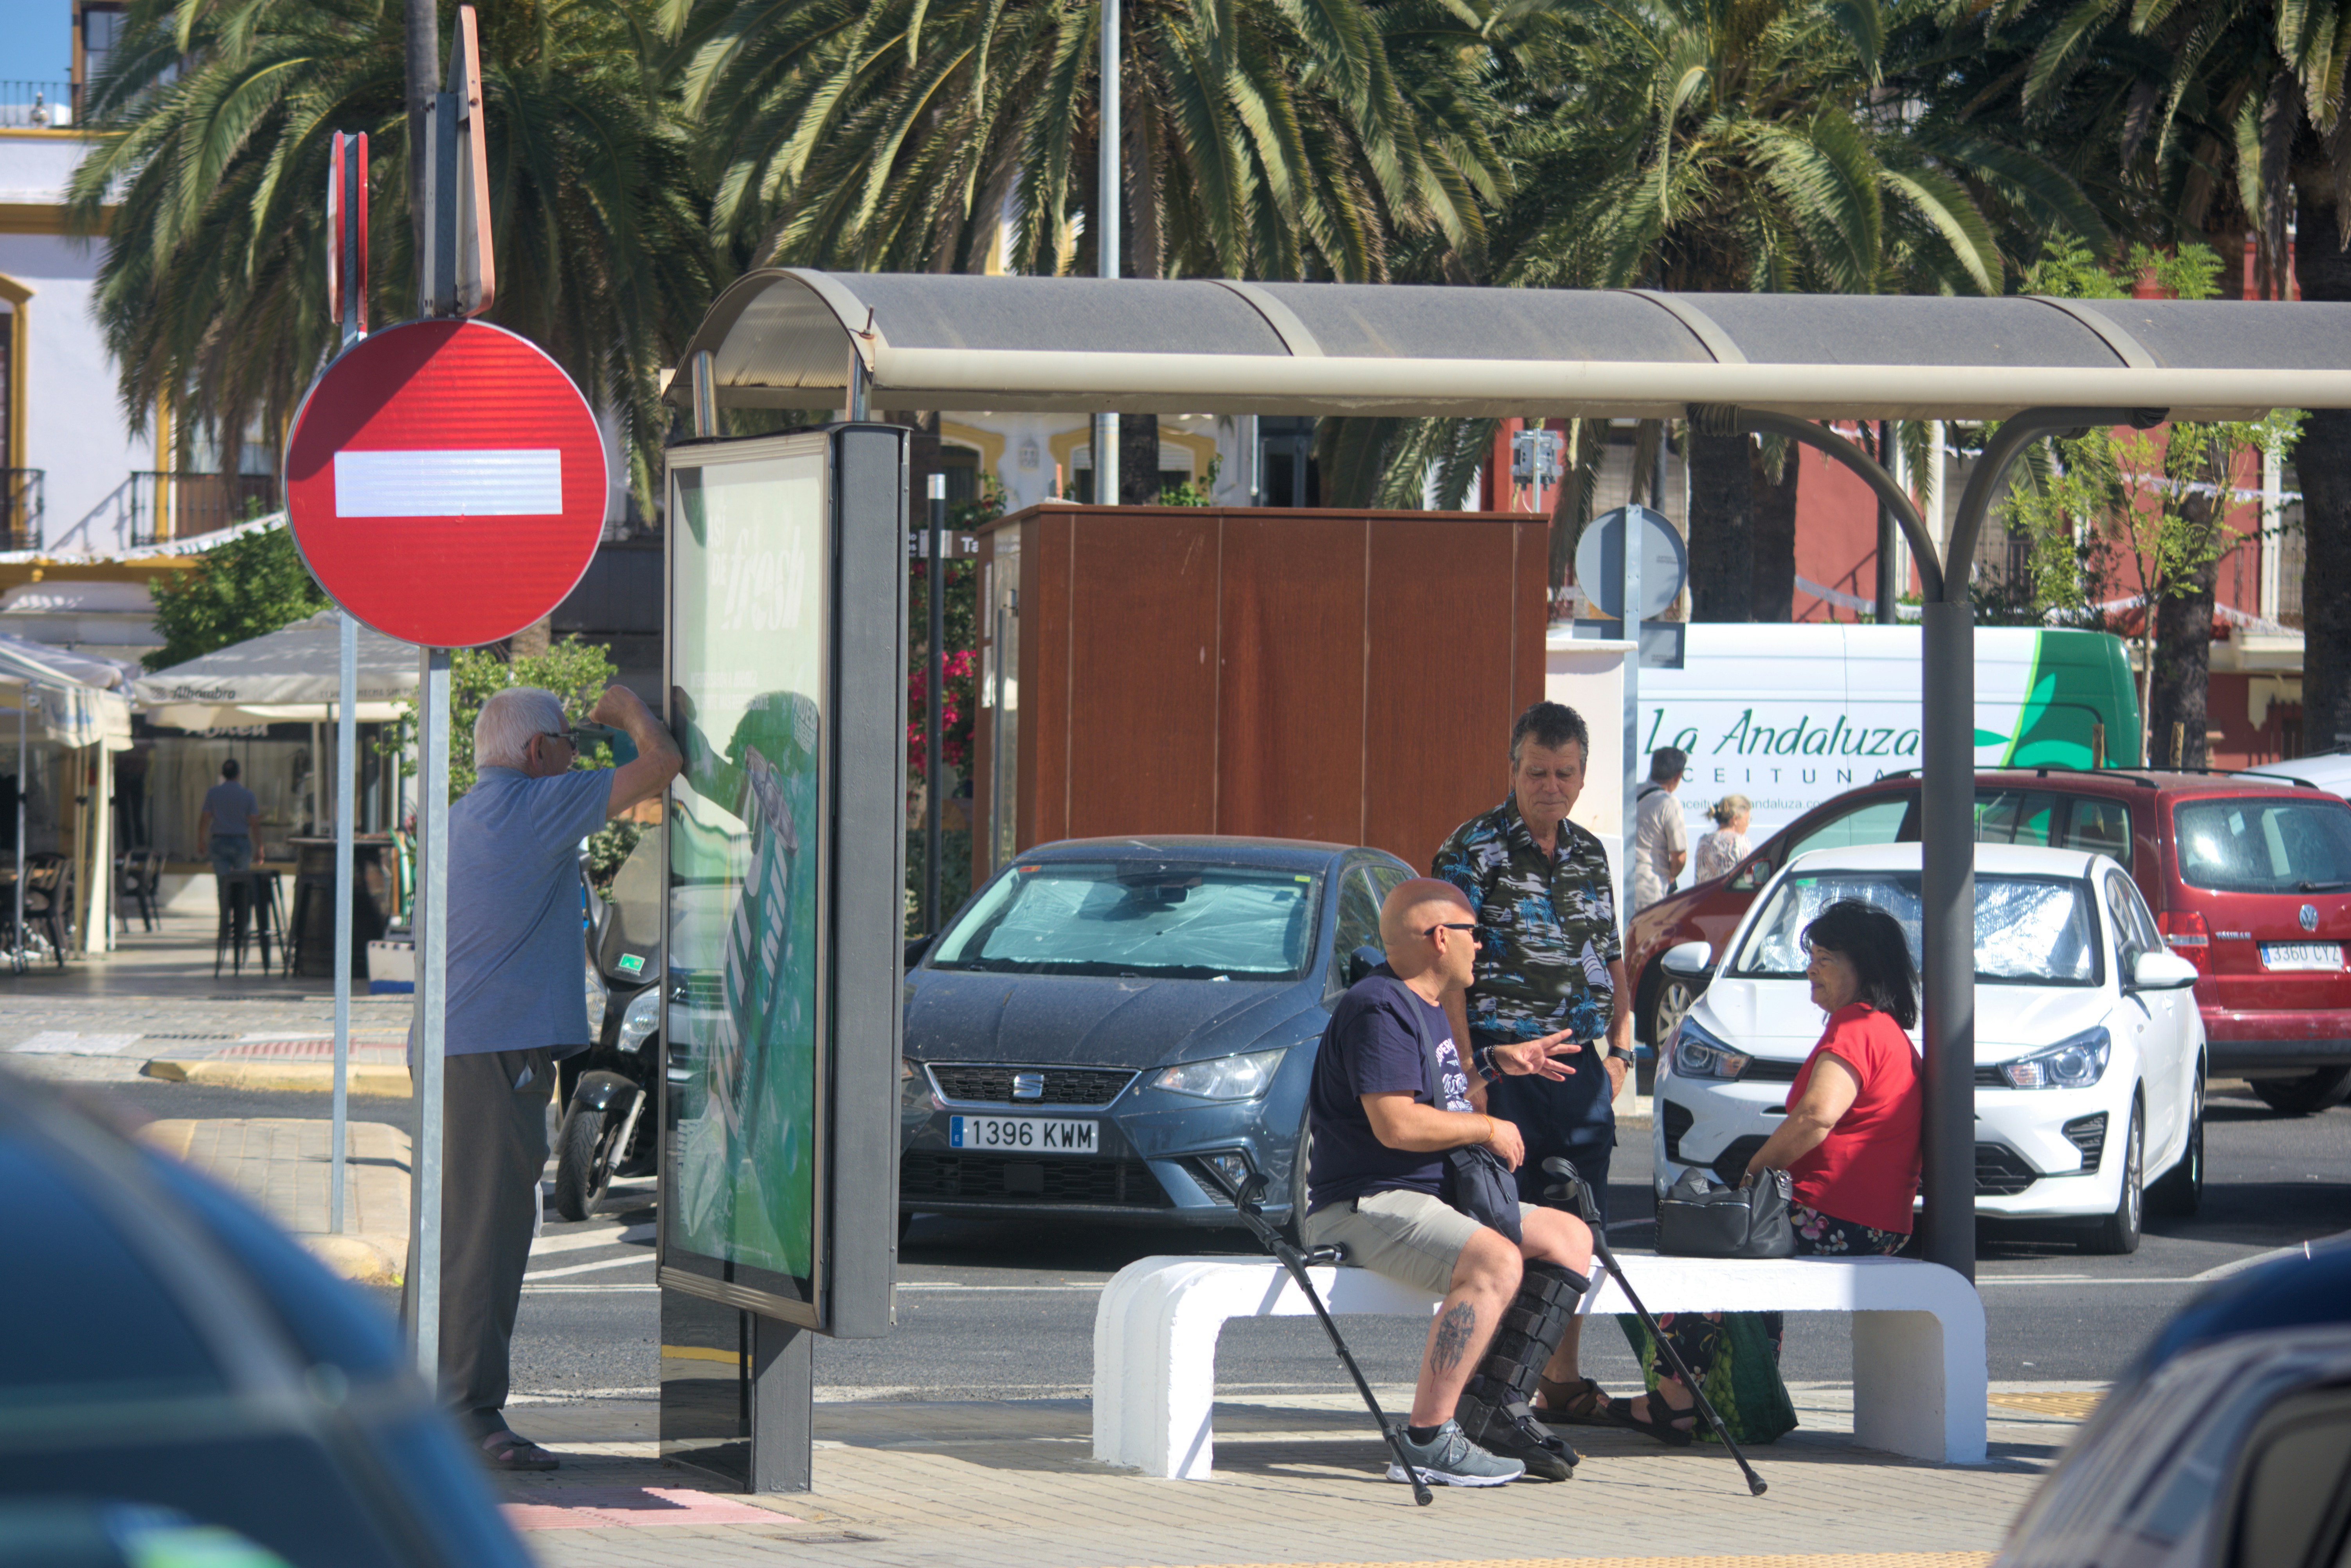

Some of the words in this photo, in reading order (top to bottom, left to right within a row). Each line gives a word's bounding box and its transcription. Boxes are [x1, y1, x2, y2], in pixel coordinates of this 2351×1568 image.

[711, 552, 727, 586] DE
[720, 525, 805, 631] fresh
[172, 686, 236, 699] Alhambra
[792, 691, 817, 733] PRUEB
[1644, 708, 1699, 755] La
[1712, 708, 1922, 756] Andaluza
[2272, 943, 2308, 962] 3360
[738, 1058, 751, 1127] MENTA
[973, 1120, 1033, 1146] 1396
[1044, 1122, 1092, 1148] KWM
